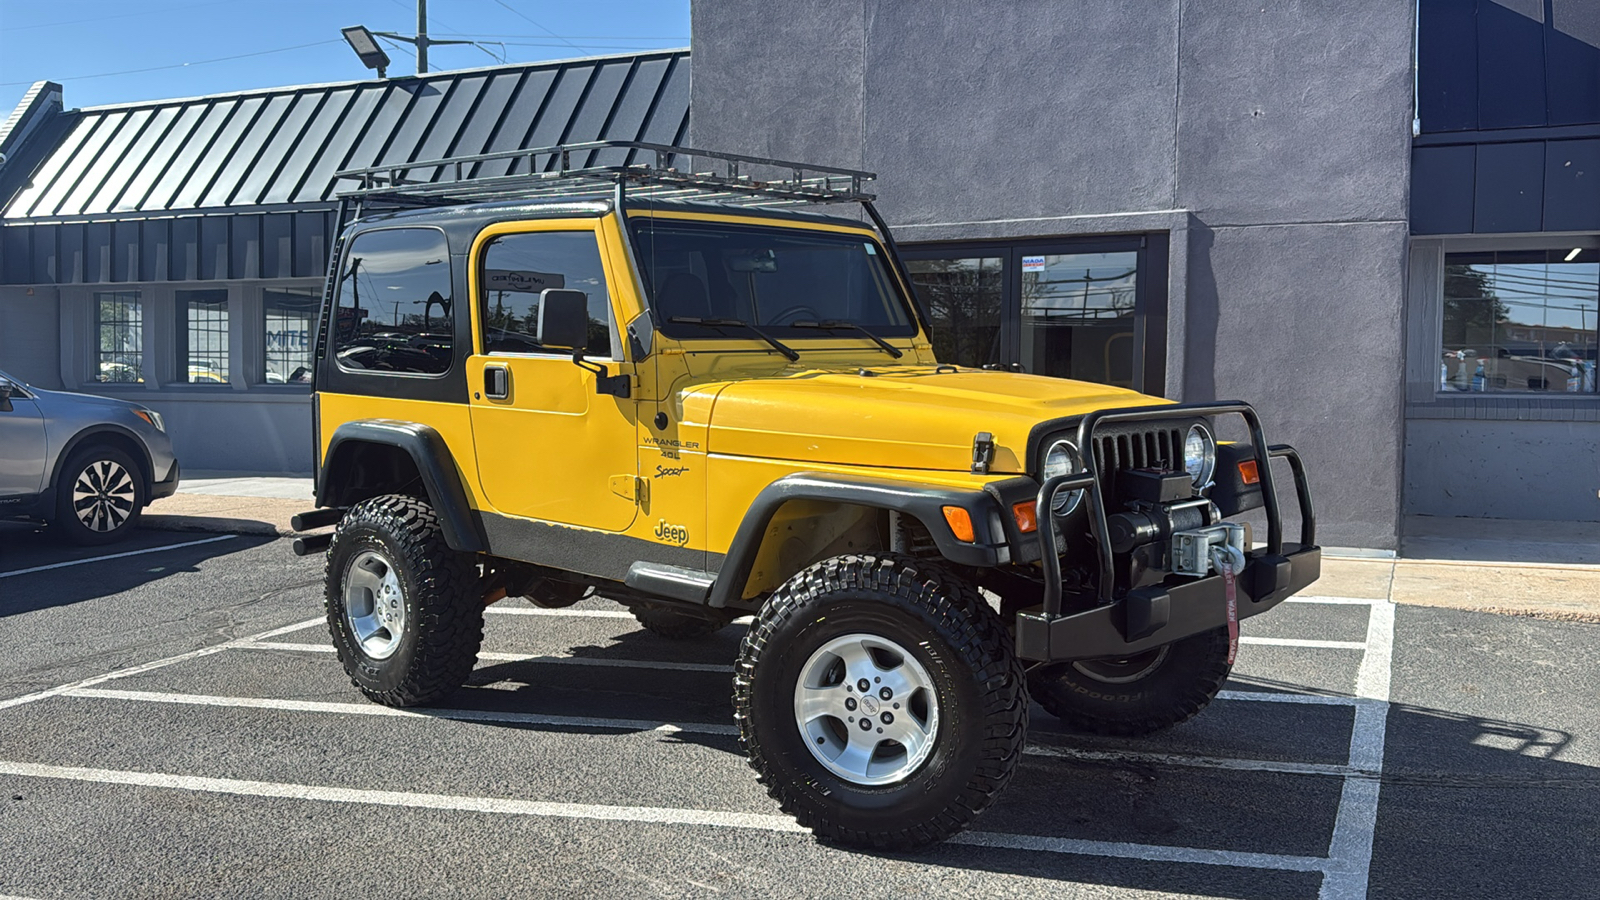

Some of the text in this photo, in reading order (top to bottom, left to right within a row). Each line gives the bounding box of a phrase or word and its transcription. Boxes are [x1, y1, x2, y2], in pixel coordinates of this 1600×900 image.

[643, 437, 700, 449] WRANGLER
[654, 519, 689, 546] Jeep
[1227, 600, 1237, 622] WARN
